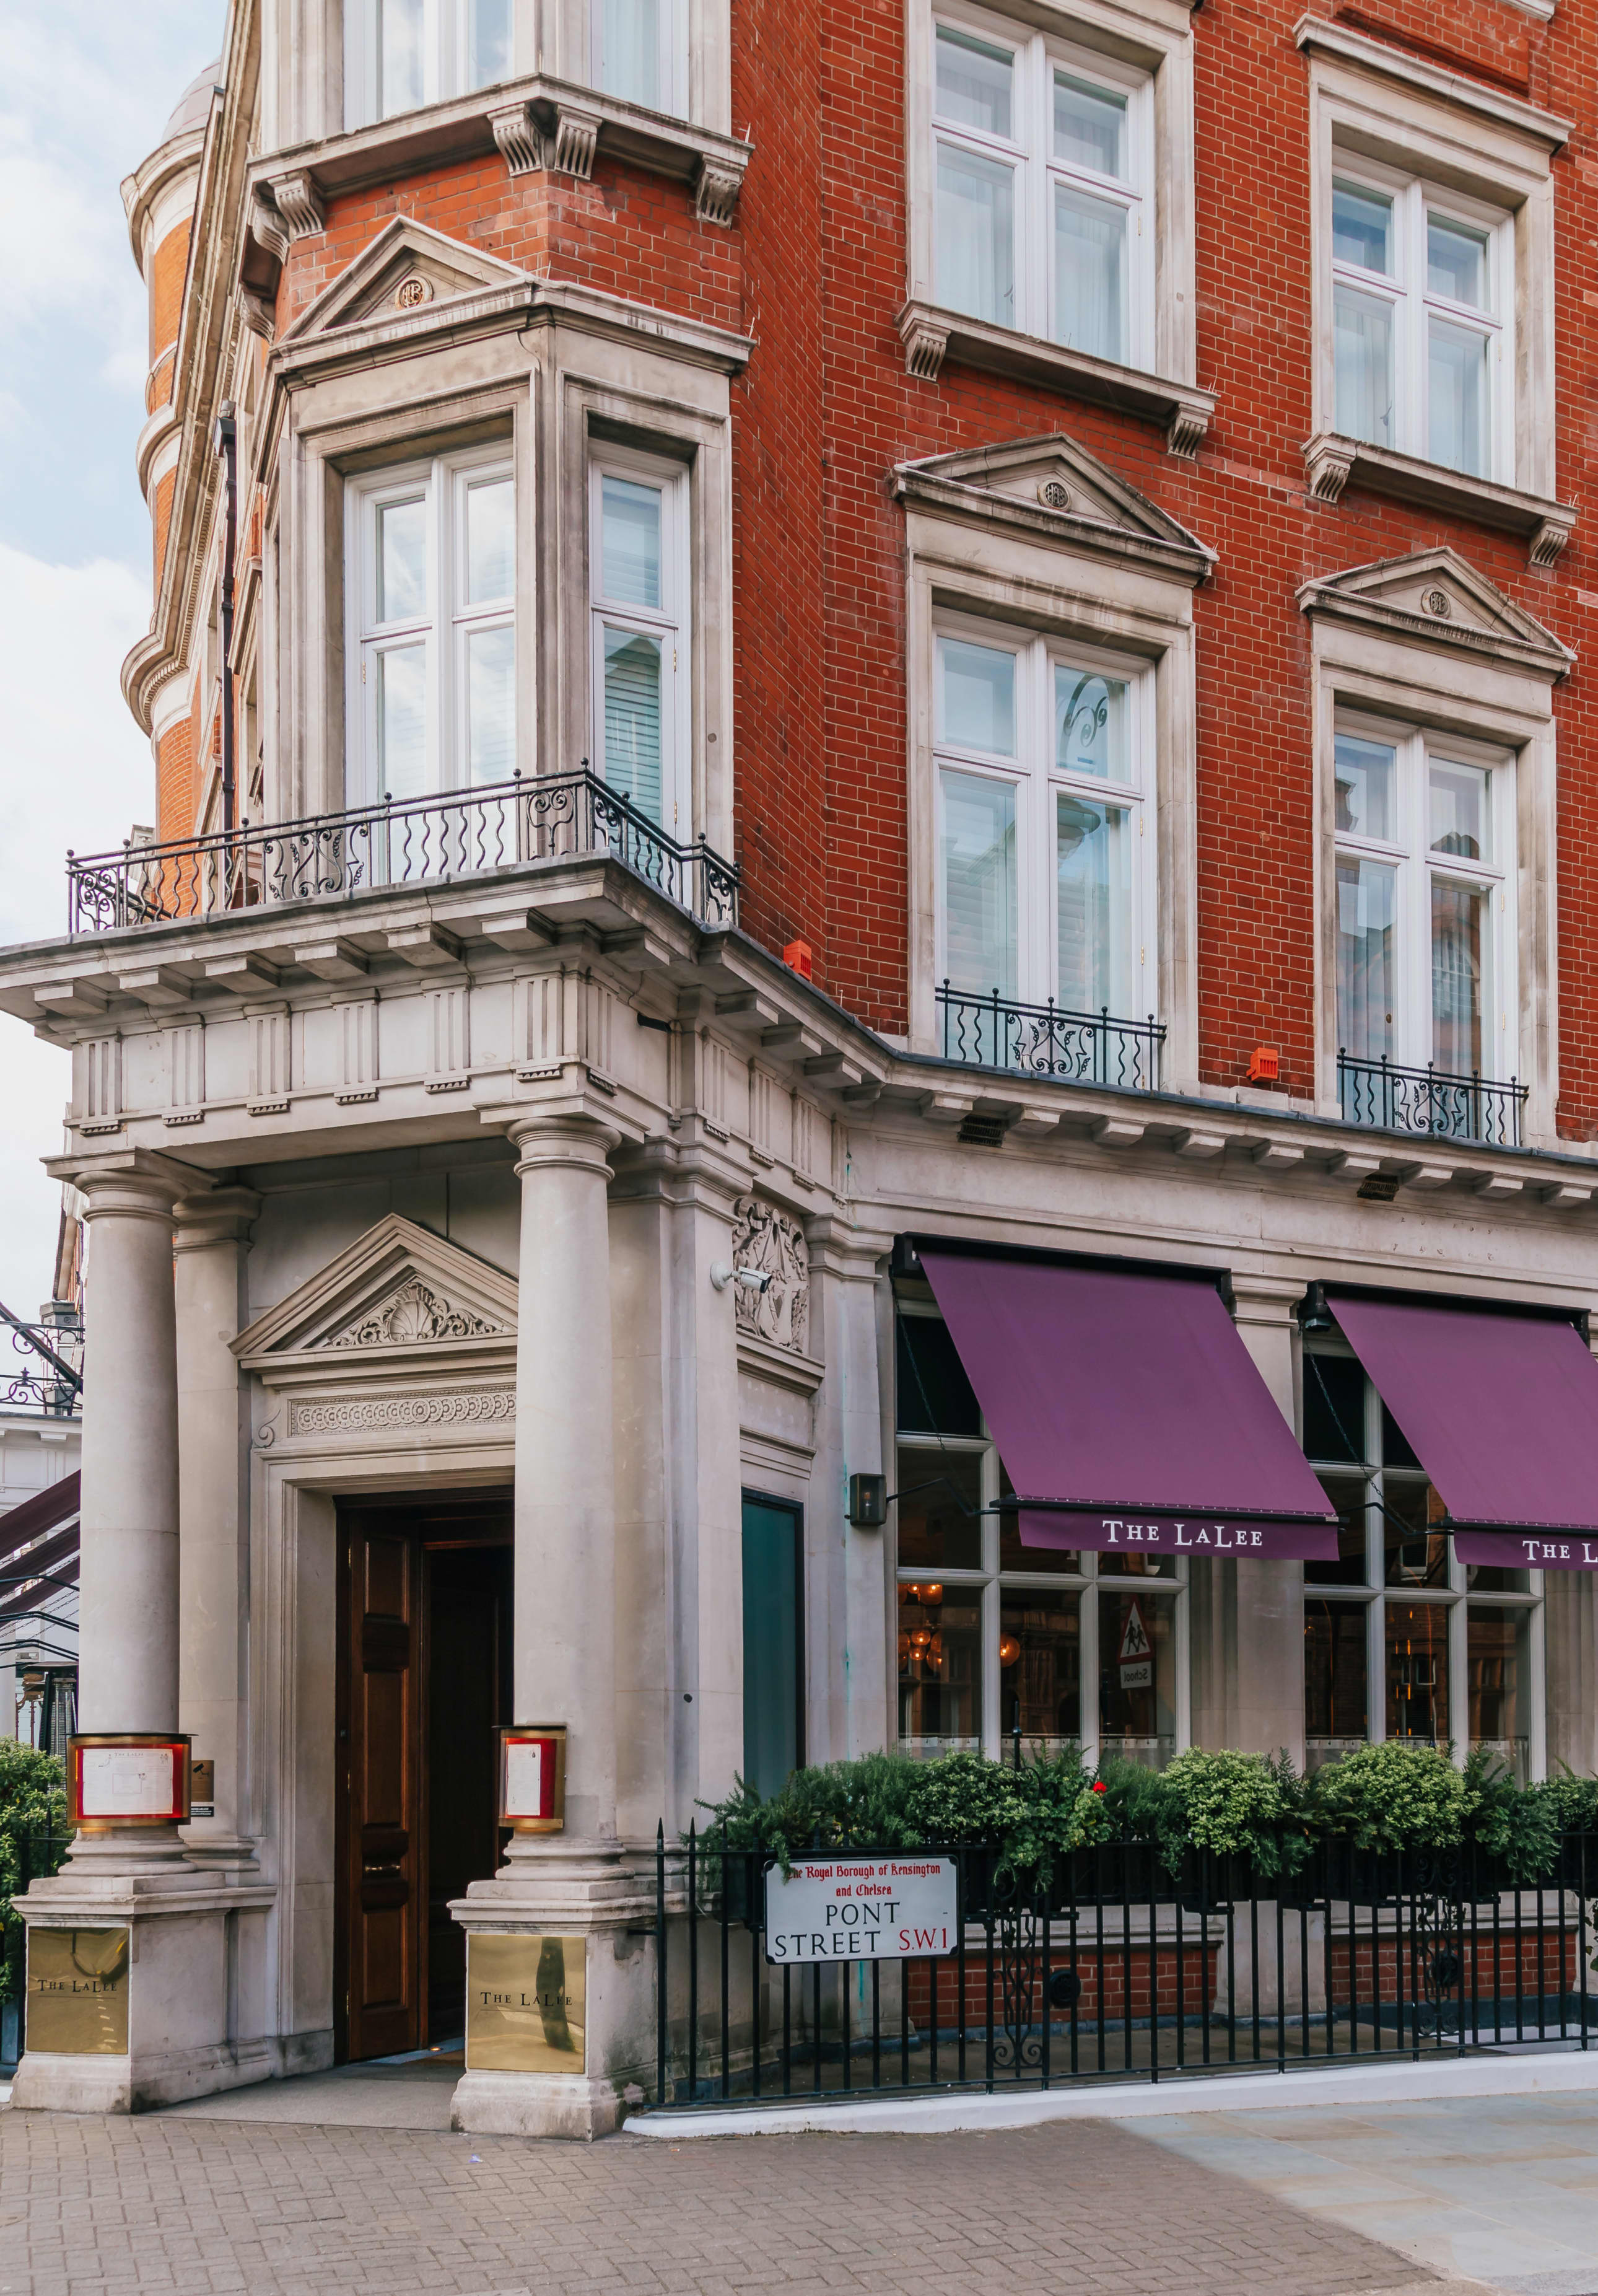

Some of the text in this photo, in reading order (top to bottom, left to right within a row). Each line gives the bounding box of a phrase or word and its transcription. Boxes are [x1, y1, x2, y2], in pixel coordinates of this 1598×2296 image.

[805, 1865, 832, 1882] Royal
[836, 1864, 874, 1880] Borough
[878, 1864, 888, 1876] of
[891, 1862, 940, 1878] Kensington
[836, 1883, 892, 1896] and Chelsea
[826, 1901, 900, 1926] PONT
[775, 1927, 947, 1957] STREET S.W.1
